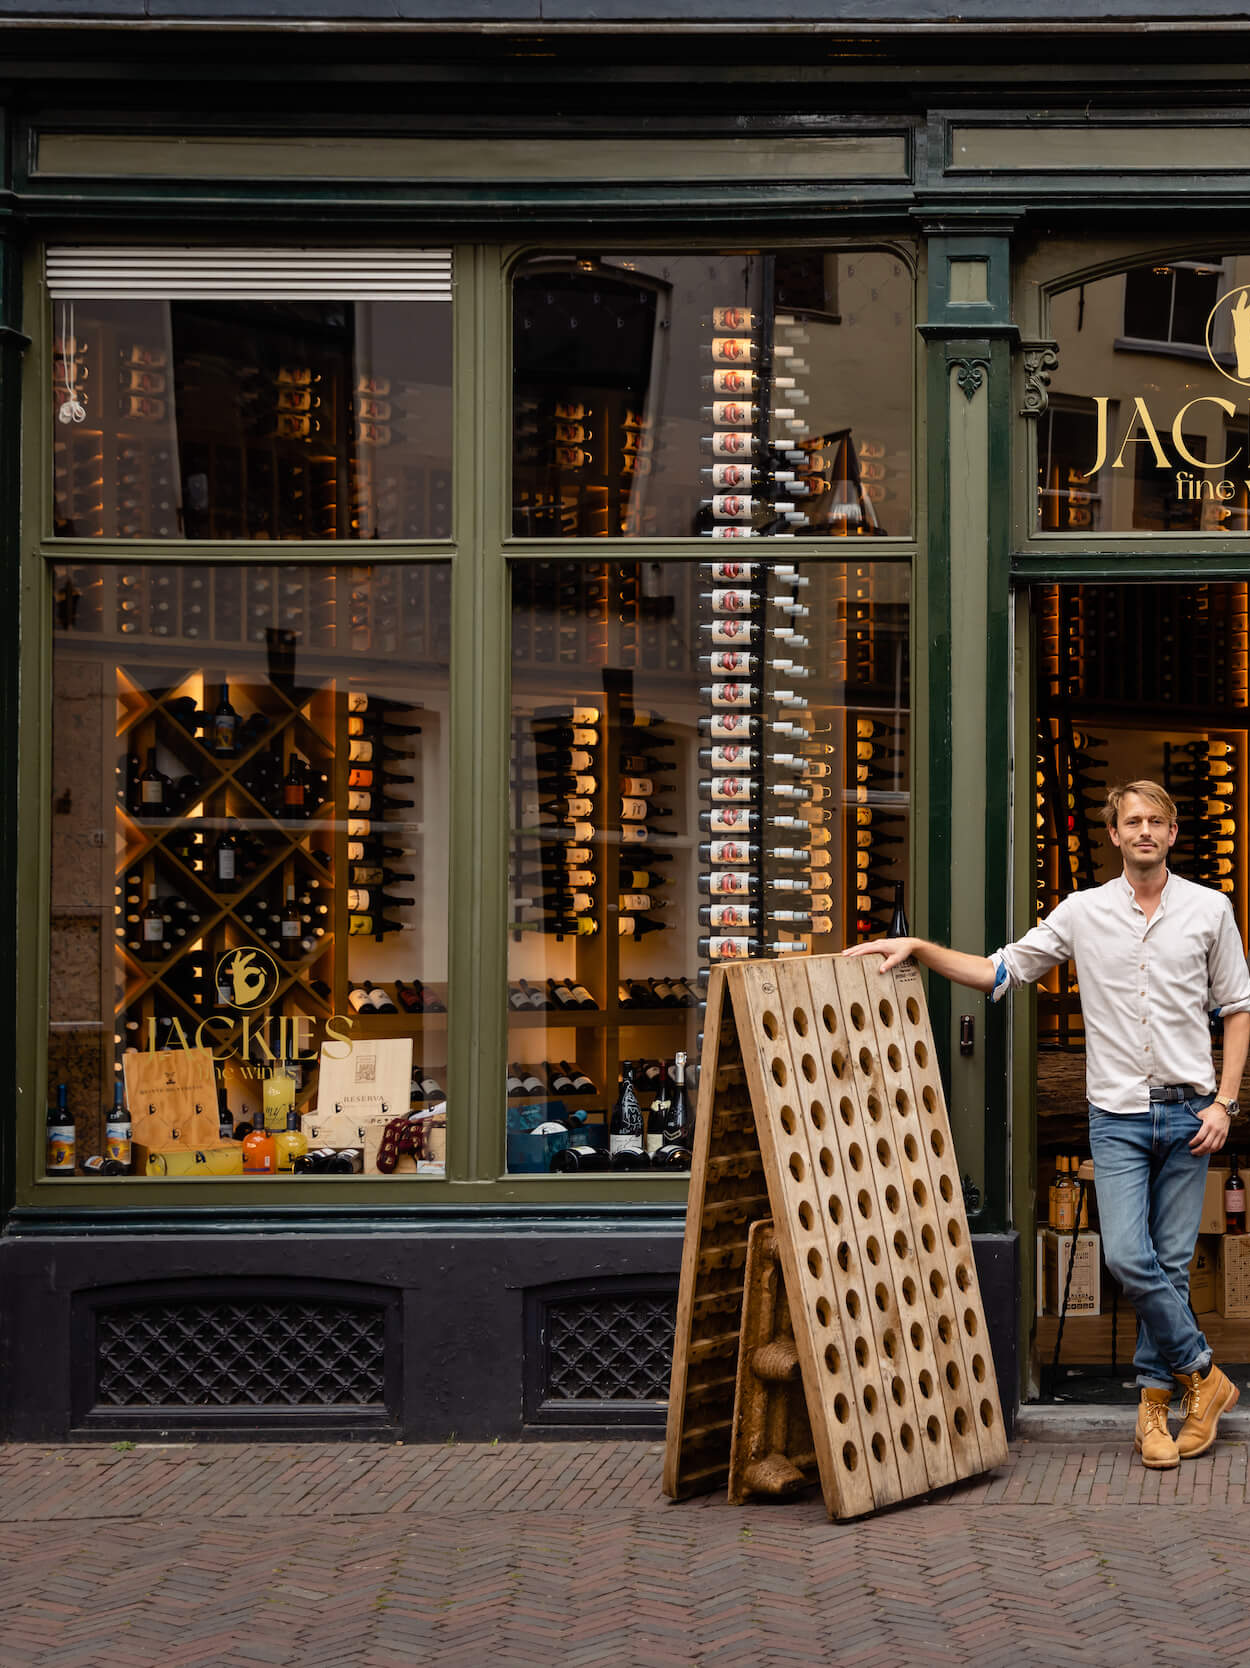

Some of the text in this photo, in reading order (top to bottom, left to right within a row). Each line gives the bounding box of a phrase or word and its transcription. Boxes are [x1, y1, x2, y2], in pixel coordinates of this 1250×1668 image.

[1176, 471, 1236, 500] fine
[144, 1015, 354, 1063] JACKIES
[343, 1095, 385, 1103] RESERVA
